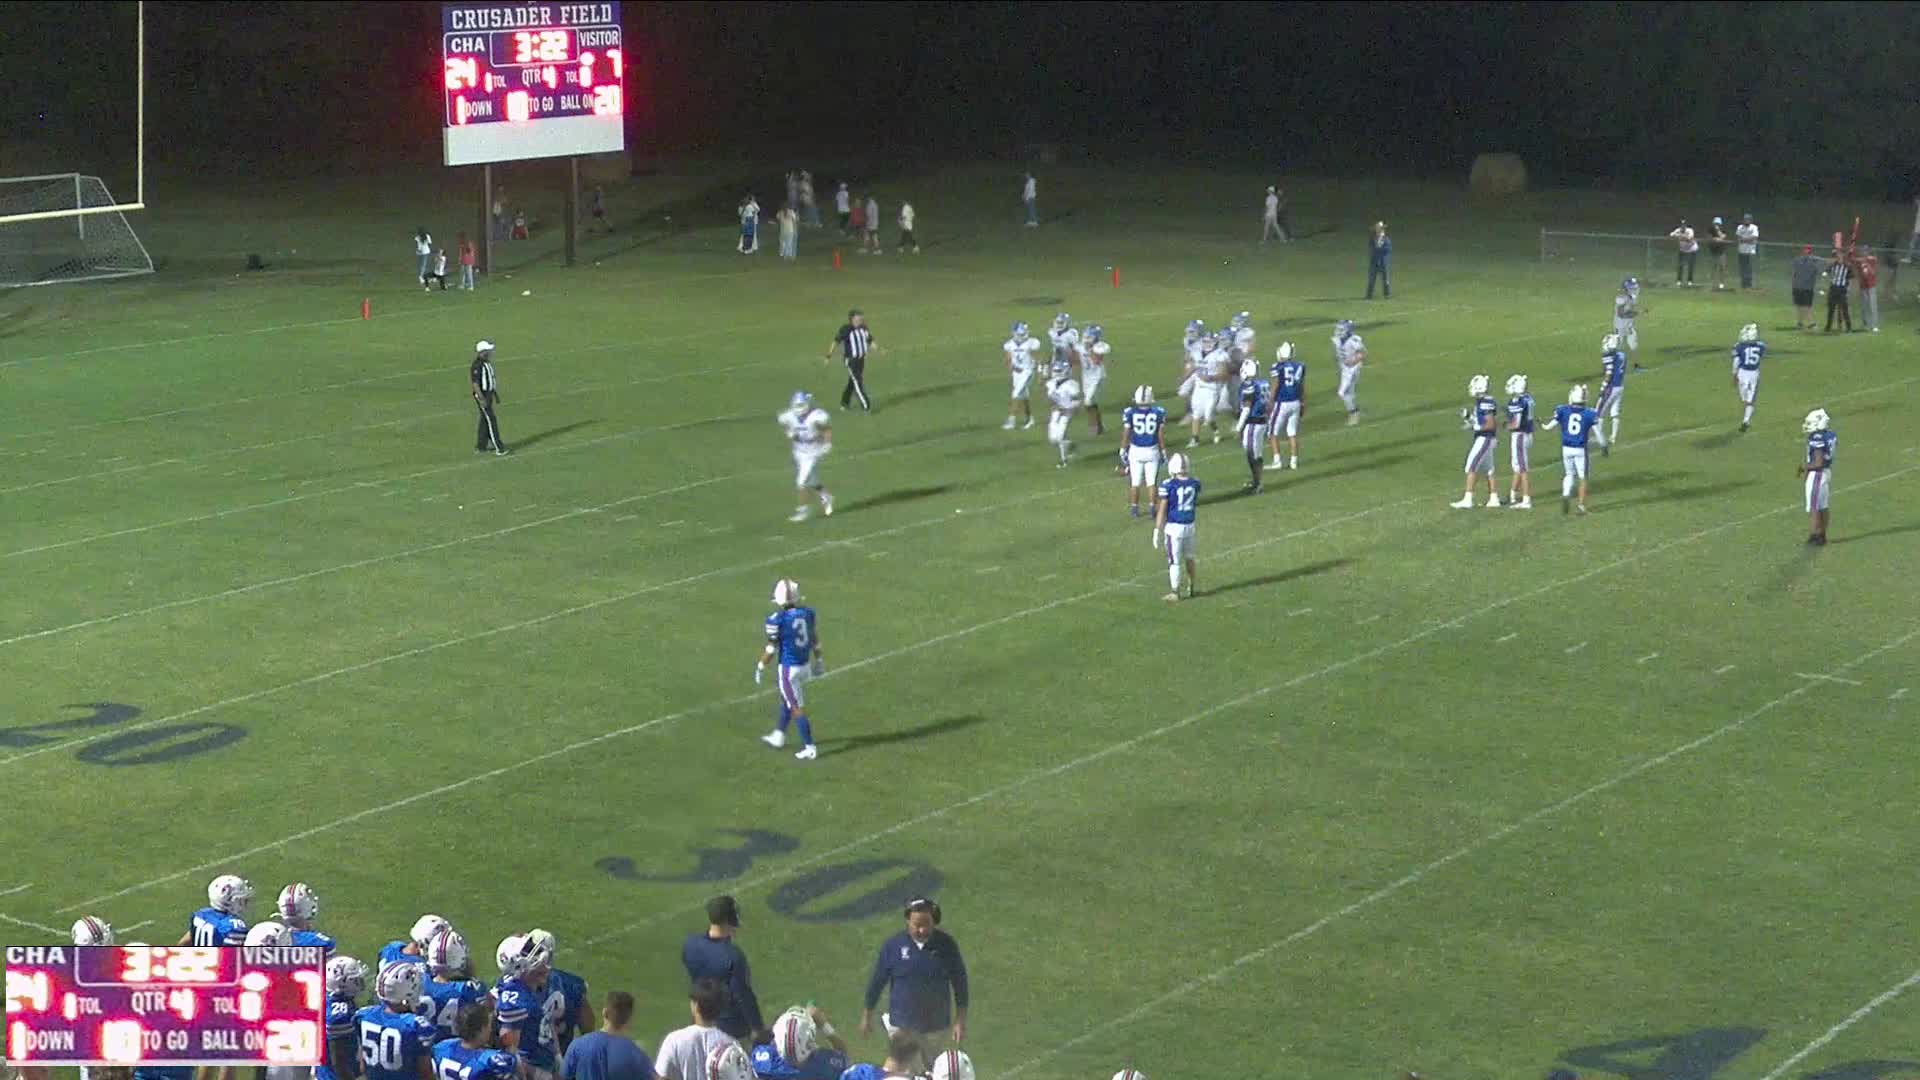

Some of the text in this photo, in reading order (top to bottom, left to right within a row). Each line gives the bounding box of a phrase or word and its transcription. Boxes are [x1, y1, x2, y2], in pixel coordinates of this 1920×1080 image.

[452, 4, 612, 29] CRUSADER FIELD
[451, 37, 485, 53] CHA
[515, 31, 568, 62] 3:22
[580, 30, 619, 47] VISITOR
[493, 75, 506, 88] TOL
[522, 69, 541, 86] QTR
[542, 66, 557, 89] 4
[566, 71, 579, 83] TOL
[465, 101, 492, 116] DOWN
[529, 97, 553, 112] TO GO
[561, 93, 594, 110] BALL ON
[1744, 346, 1761, 366] 15
[1283, 364, 1303, 386] 54
[1132, 412, 1157, 435] 56
[1567, 412, 1583, 435] 6
[1176, 485, 1196, 512] 12
[792, 618, 808, 647] 3
[594, 827, 946, 924] 30
[501, 990, 519, 1004] 62
[331, 1001, 348, 1015] 28
[361, 1020, 402, 1071] 50
